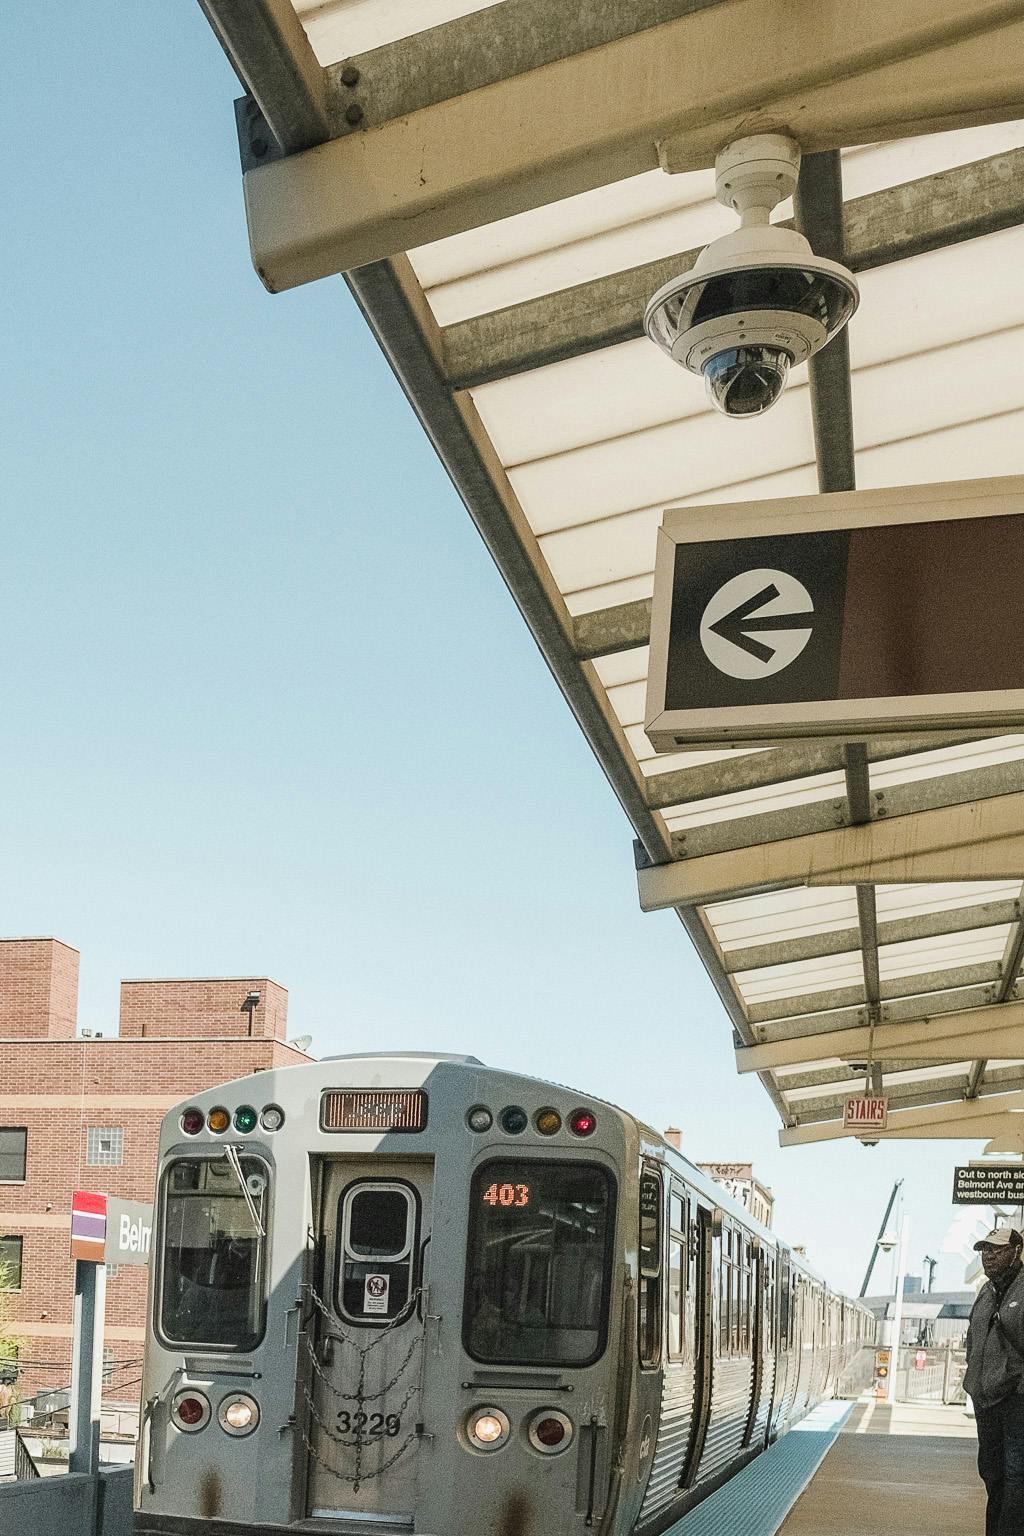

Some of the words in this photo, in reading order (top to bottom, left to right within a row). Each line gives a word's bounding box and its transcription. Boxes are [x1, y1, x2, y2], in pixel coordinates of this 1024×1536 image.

[847, 1100, 884, 1119] STAIRS
[958, 1169, 975, 1178] Out
[976, 1170, 986, 1178] to
[987, 1170, 1012, 1179] north
[957, 1180, 995, 1189] Belmont
[996, 1180, 1014, 1189] Ave
[483, 1183, 529, 1206] 403
[957, 1190, 1005, 1199] westbound
[336, 1410, 401, 1437] 3229
